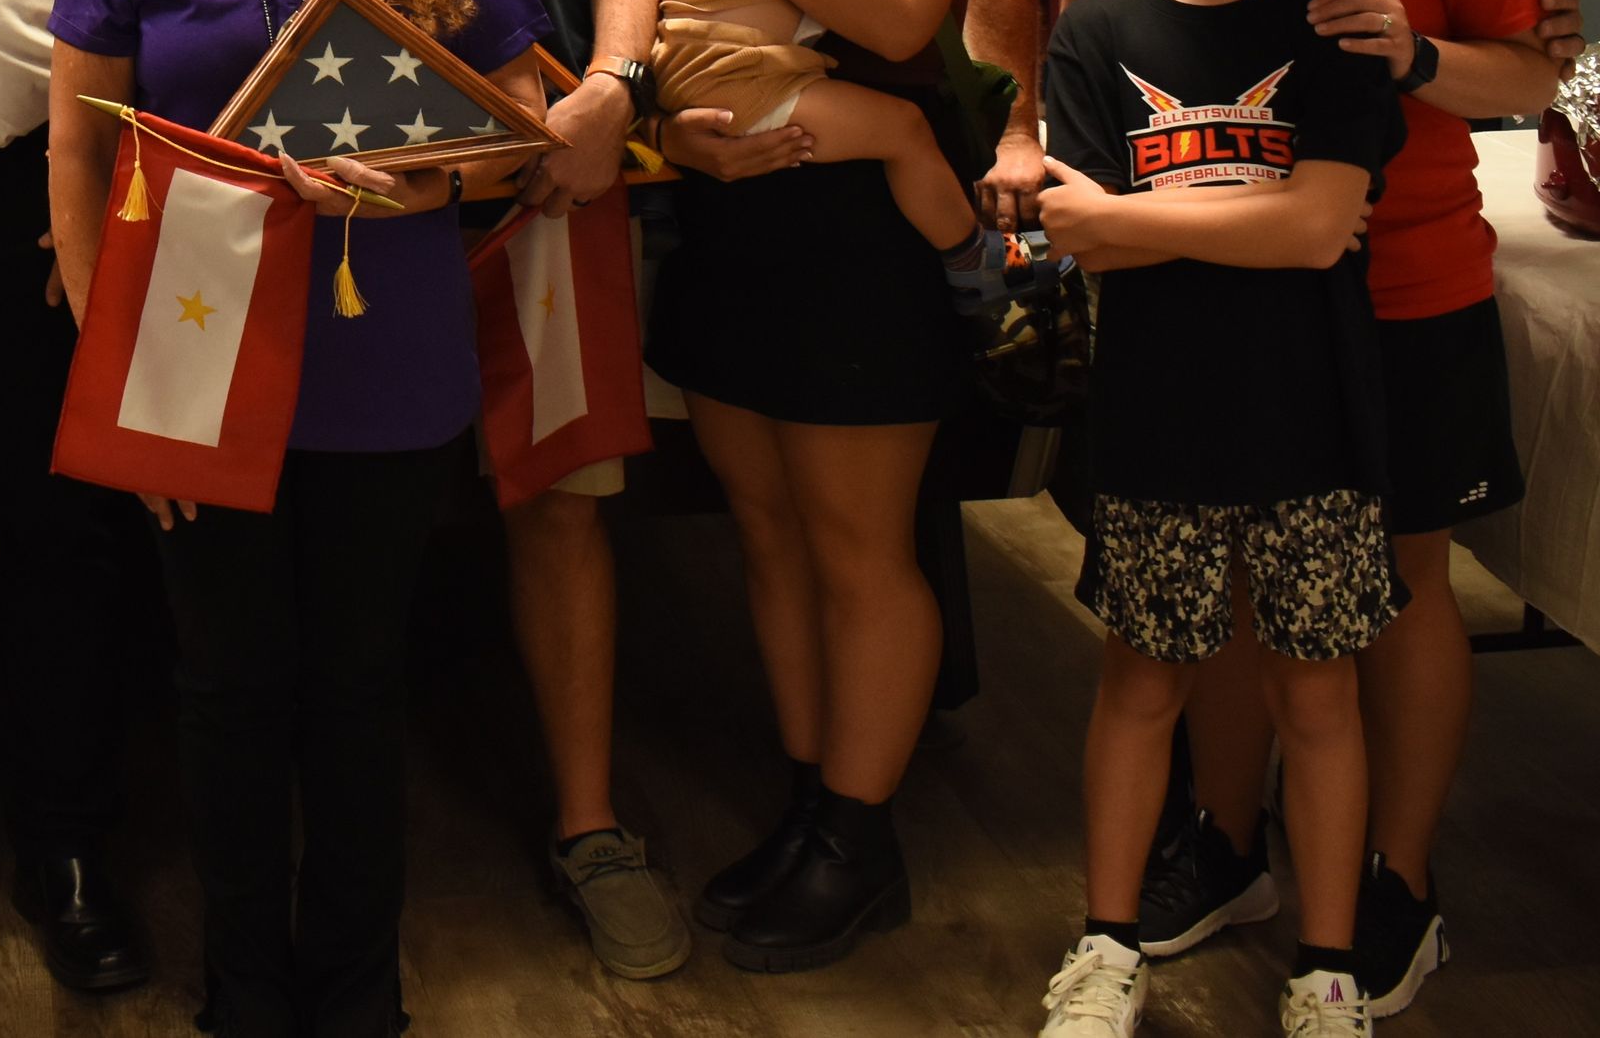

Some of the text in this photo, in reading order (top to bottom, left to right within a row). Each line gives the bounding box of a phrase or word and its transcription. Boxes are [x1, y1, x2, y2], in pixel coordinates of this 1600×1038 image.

[1152, 107, 1270, 128] ELLETTSVILLE
[1132, 127, 1294, 176] BOLTS
[1154, 165, 1277, 188] BASEBALL CLUB
